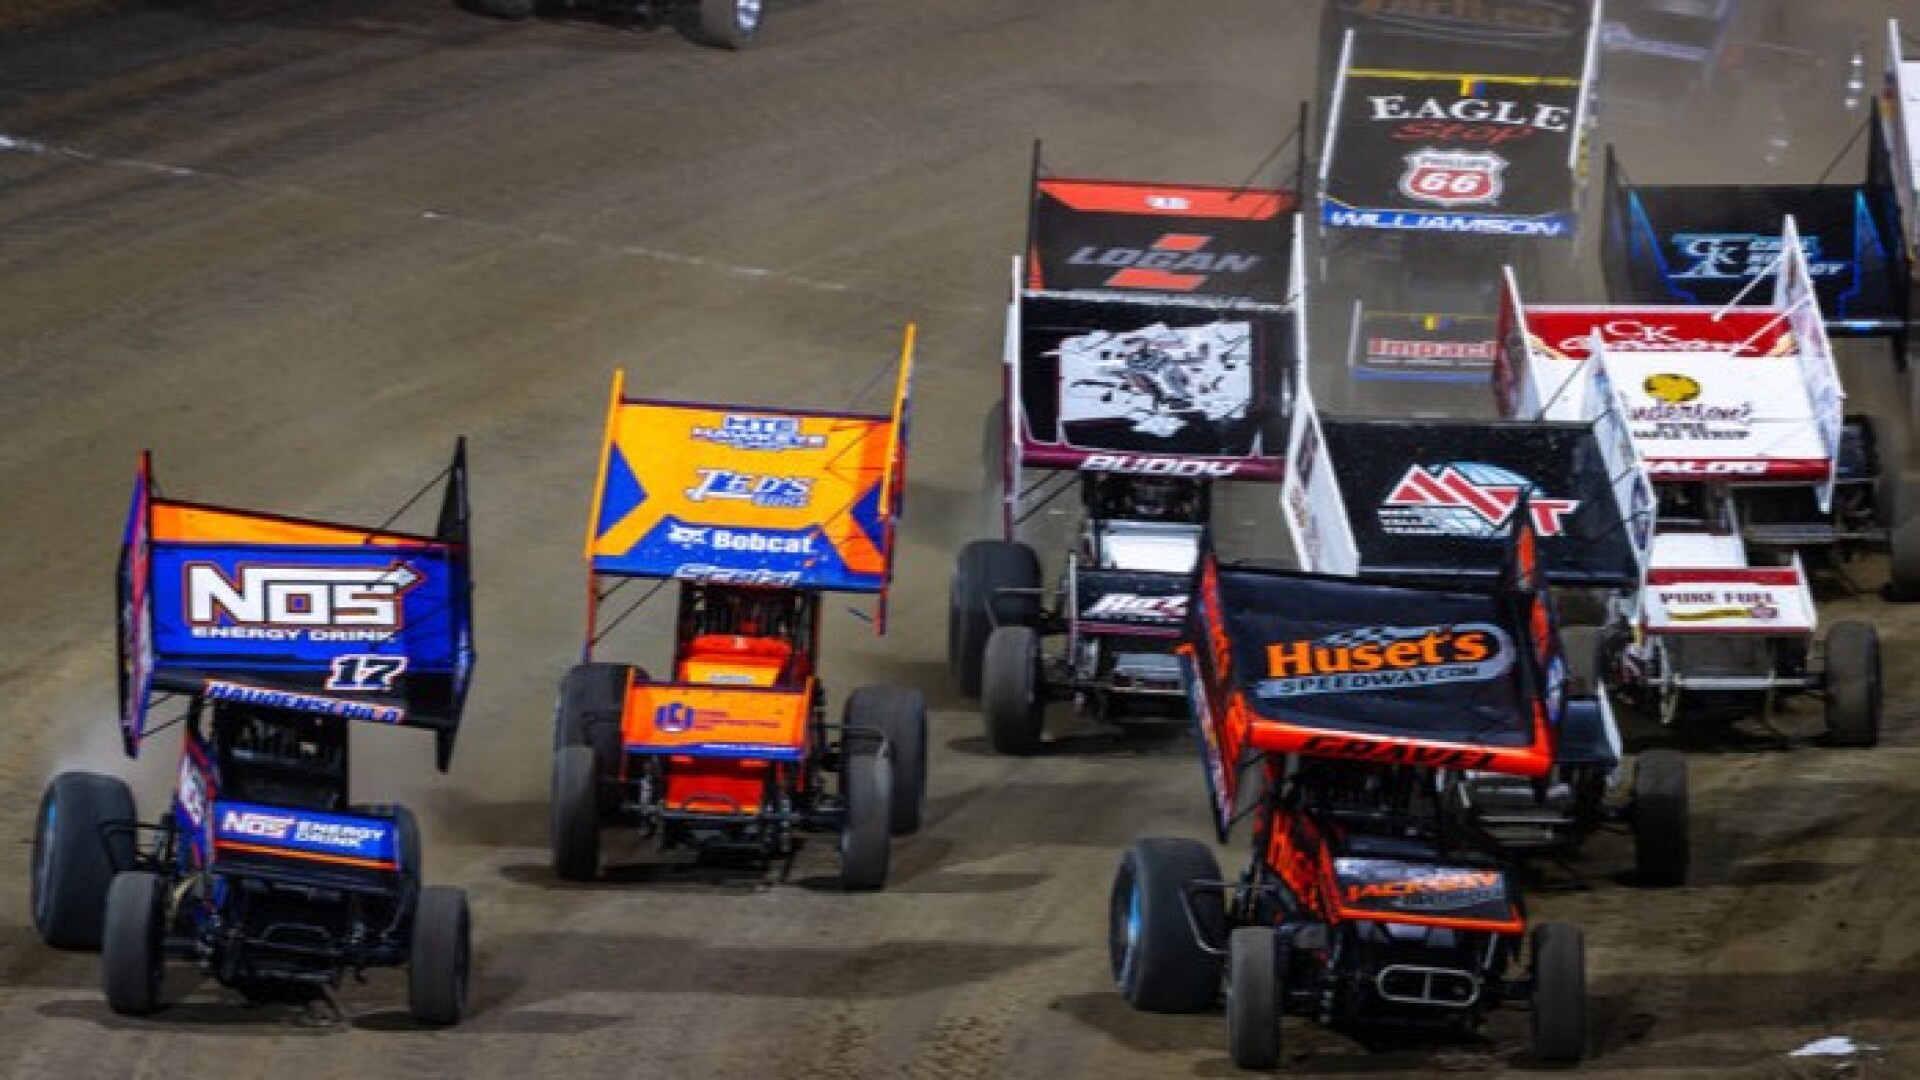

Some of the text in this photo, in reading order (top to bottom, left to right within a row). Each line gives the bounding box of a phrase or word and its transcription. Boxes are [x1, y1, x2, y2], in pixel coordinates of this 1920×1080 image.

[1367, 95, 1571, 132] EAGLE
[1419, 173, 1483, 192] 66
[1331, 211, 1561, 236] WILLIAMSON
[1066, 247, 1263, 273] LOGAN
[1081, 455, 1241, 477] BUDDY
[713, 530, 814, 552] Bobcat
[186, 561, 421, 626] NOS
[193, 627, 397, 643] ENERGY DRINK
[1265, 631, 1489, 677] Huset's
[324, 654, 409, 691] 17
[1279, 666, 1479, 693] SPEEDWAY.COM
[1302, 736, 1498, 770] GRAVEL
[221, 810, 296, 839] NOS
